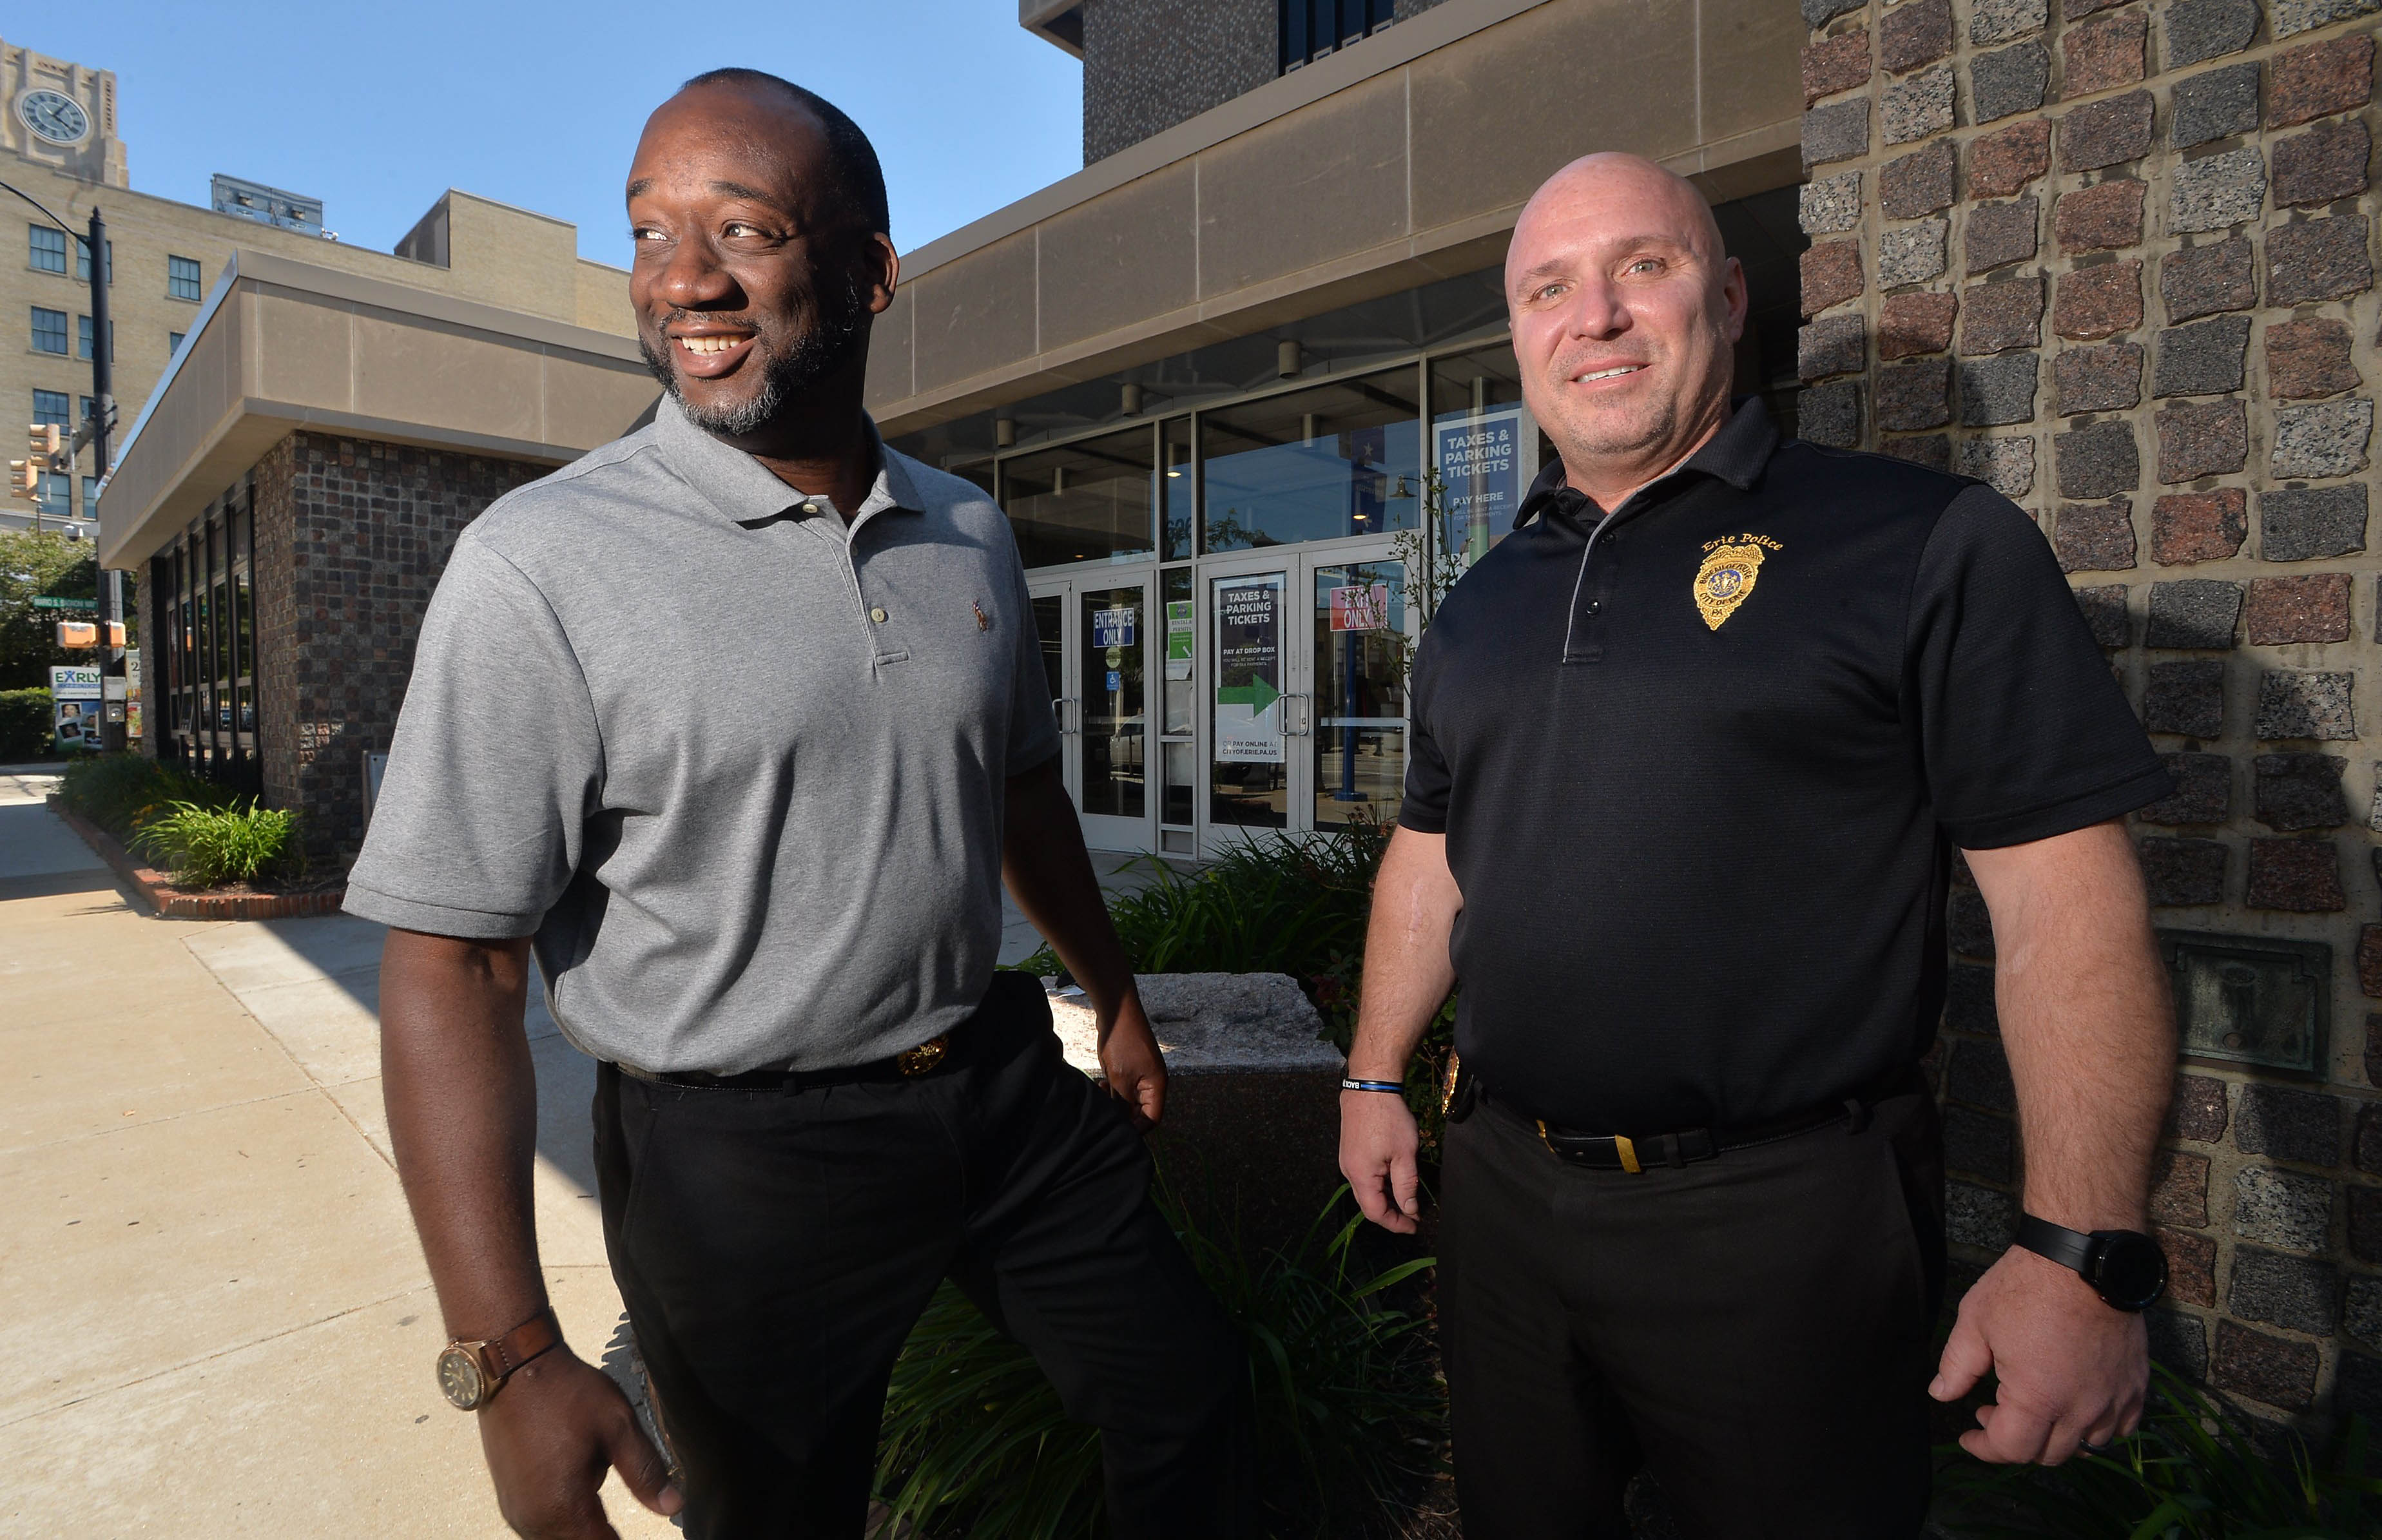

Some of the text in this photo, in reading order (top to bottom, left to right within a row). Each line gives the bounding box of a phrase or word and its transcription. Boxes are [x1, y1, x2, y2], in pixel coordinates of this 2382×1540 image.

[1448, 429, 1509, 449] TAXES &
[1446, 443, 1511, 465] PARKING
[1447, 459, 1509, 478] TICKETS
[1453, 492, 1504, 506] PAY HERE
[1701, 533, 1784, 552] Erie Police
[1228, 590, 1270, 602] TAXES &
[1700, 592, 1715, 604] CITY
[1728, 590, 1746, 604] ERIE
[1226, 602, 1272, 614] PARKING
[1095, 610, 1132, 629] ENTRANCE
[1228, 613, 1270, 625] TICKETS
[1344, 609, 1370, 628] ONLY
[1103, 628, 1122, 646] ONLY
